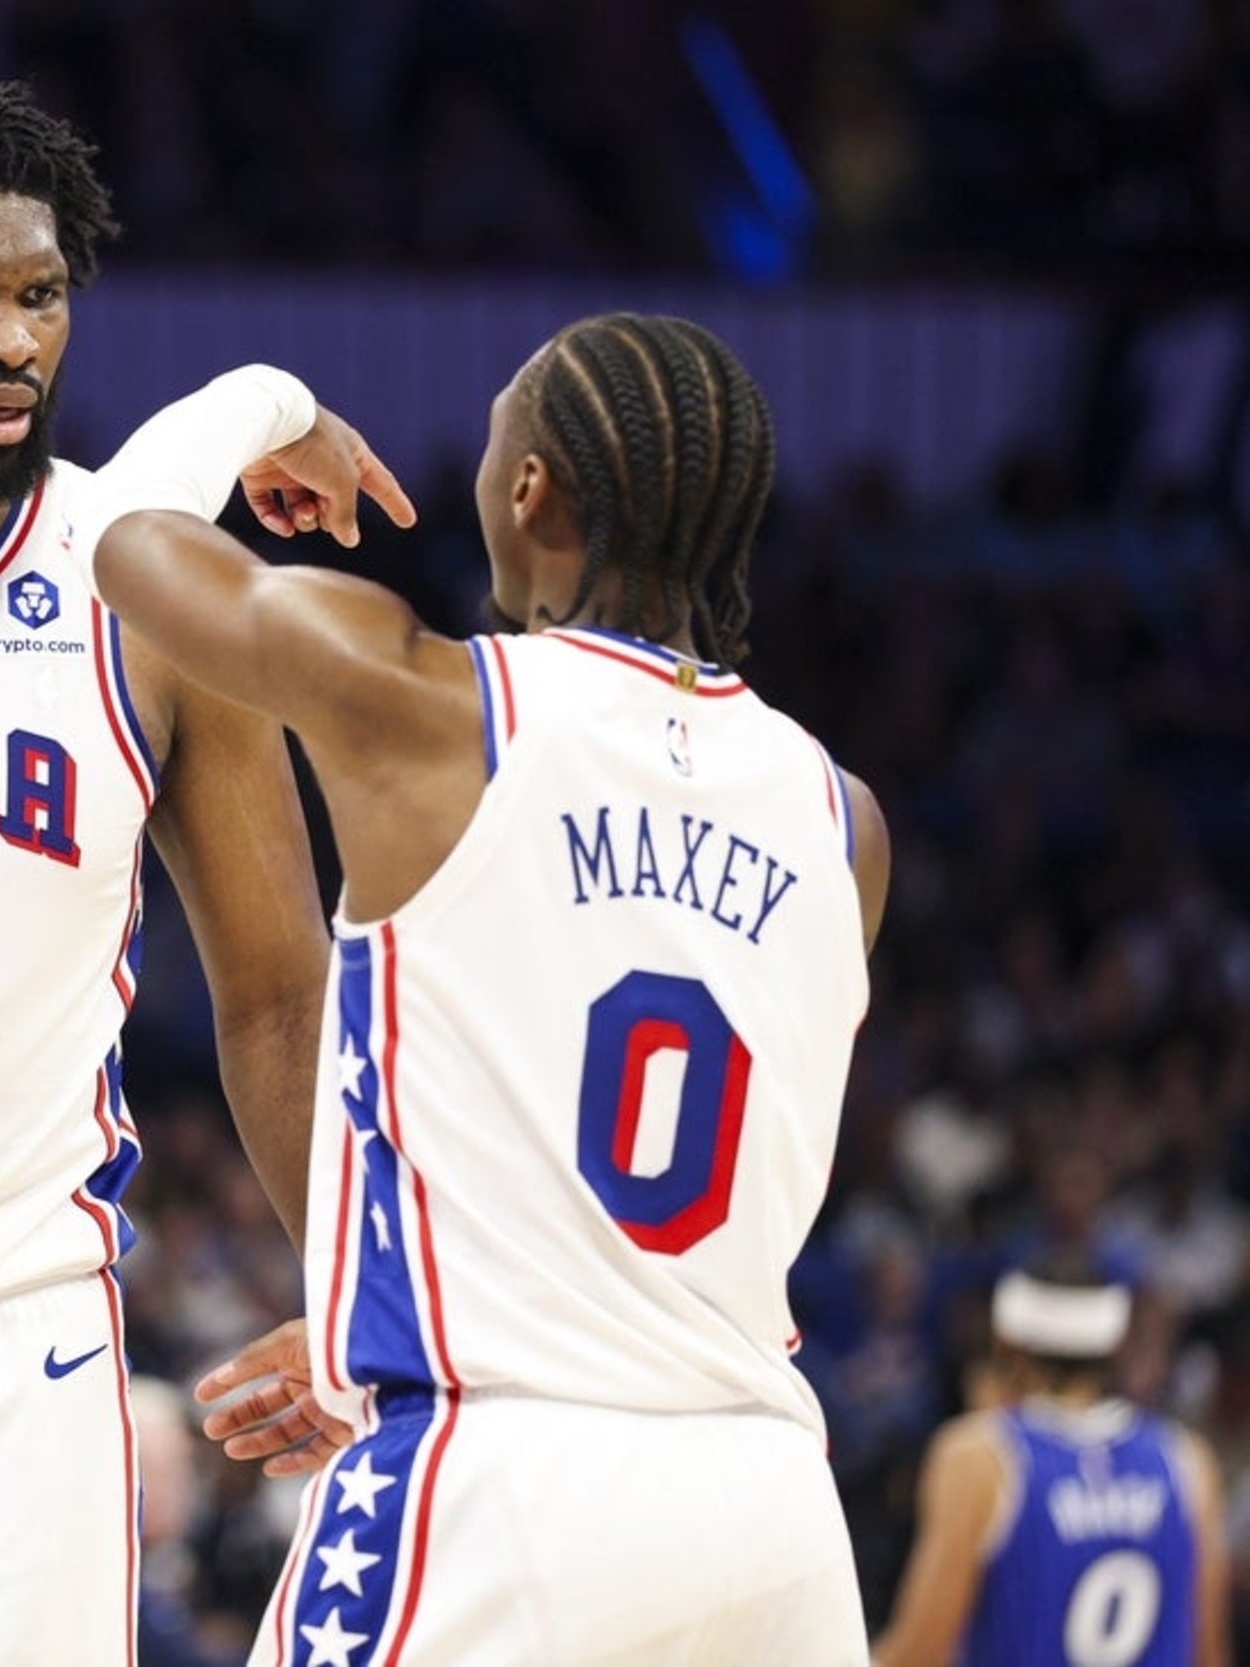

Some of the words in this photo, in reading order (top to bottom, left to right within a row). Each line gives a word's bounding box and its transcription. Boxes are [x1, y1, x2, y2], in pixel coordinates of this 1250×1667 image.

[560, 806, 798, 945] MAXEY
[576, 969, 754, 1256] 0
[1063, 1548, 1161, 1667] 0
